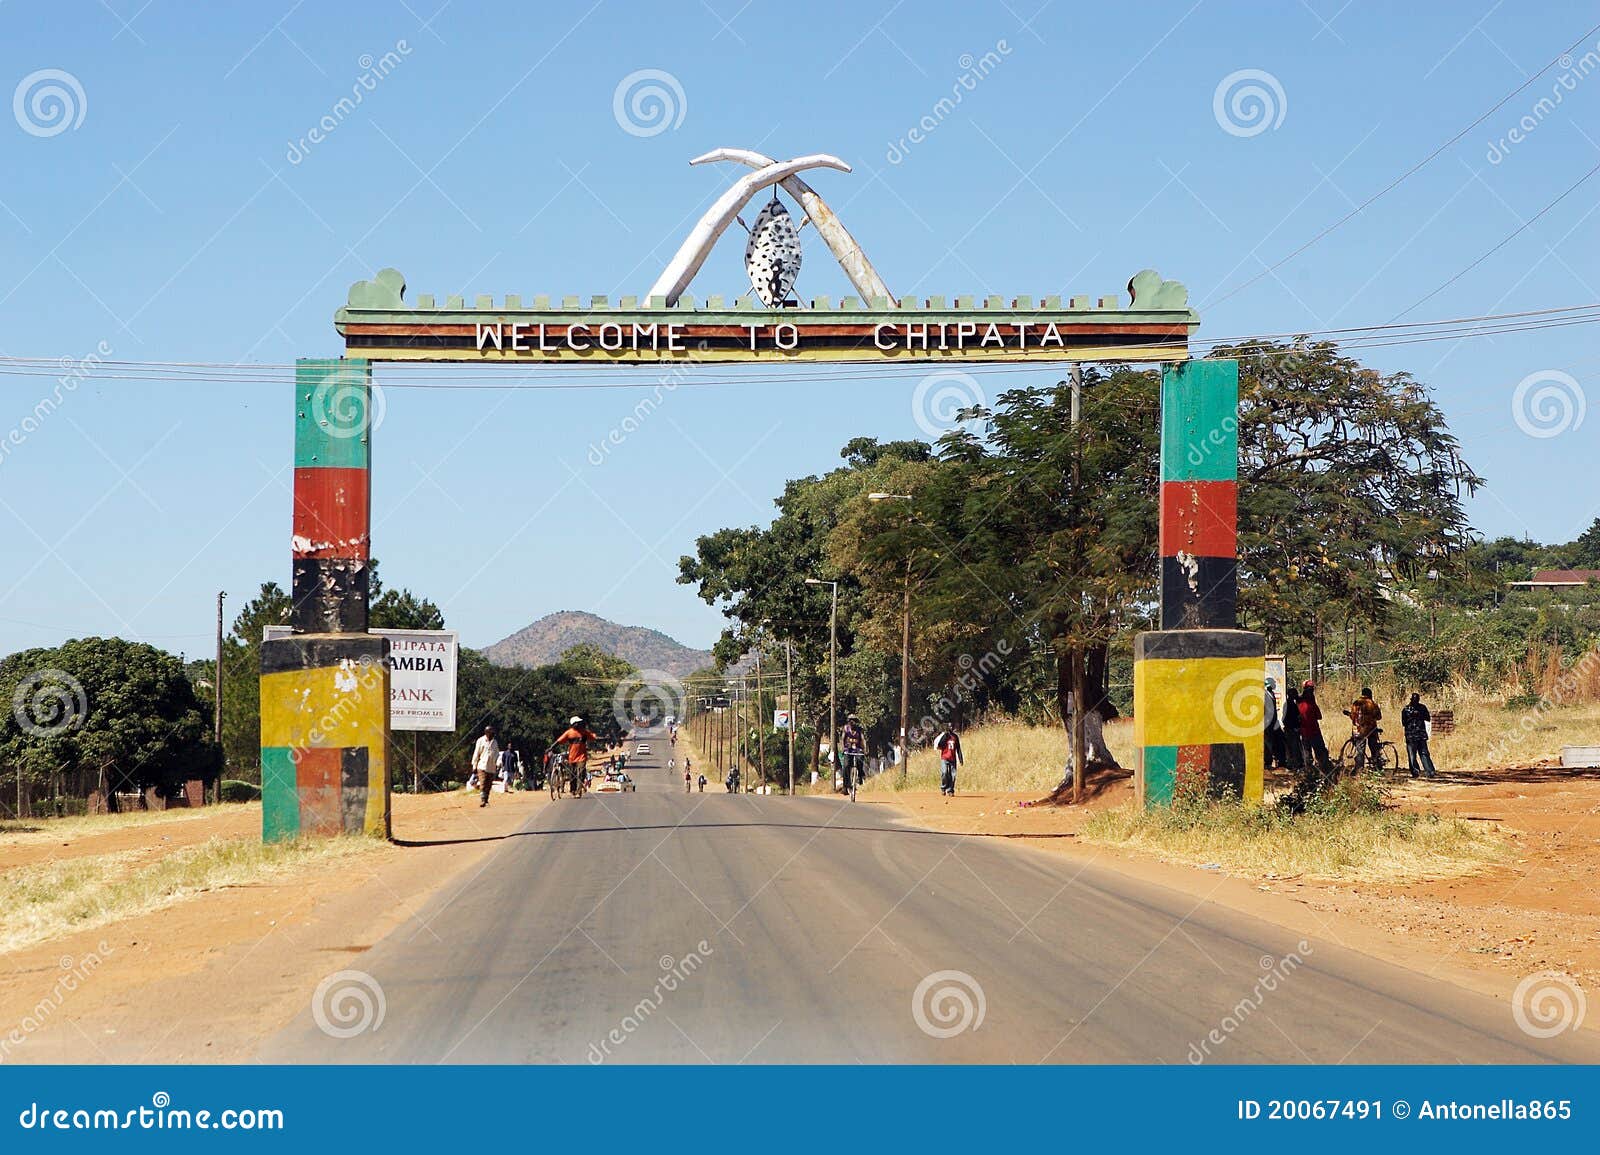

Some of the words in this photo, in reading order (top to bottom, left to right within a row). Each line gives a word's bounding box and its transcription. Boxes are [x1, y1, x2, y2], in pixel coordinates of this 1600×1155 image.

[476, 322, 686, 351] WELCOME
[741, 322, 798, 351] TO
[874, 321, 1064, 350] CHIPATA
[392, 641, 446, 652] HIPATA
[390, 657, 444, 672] AMBIA
